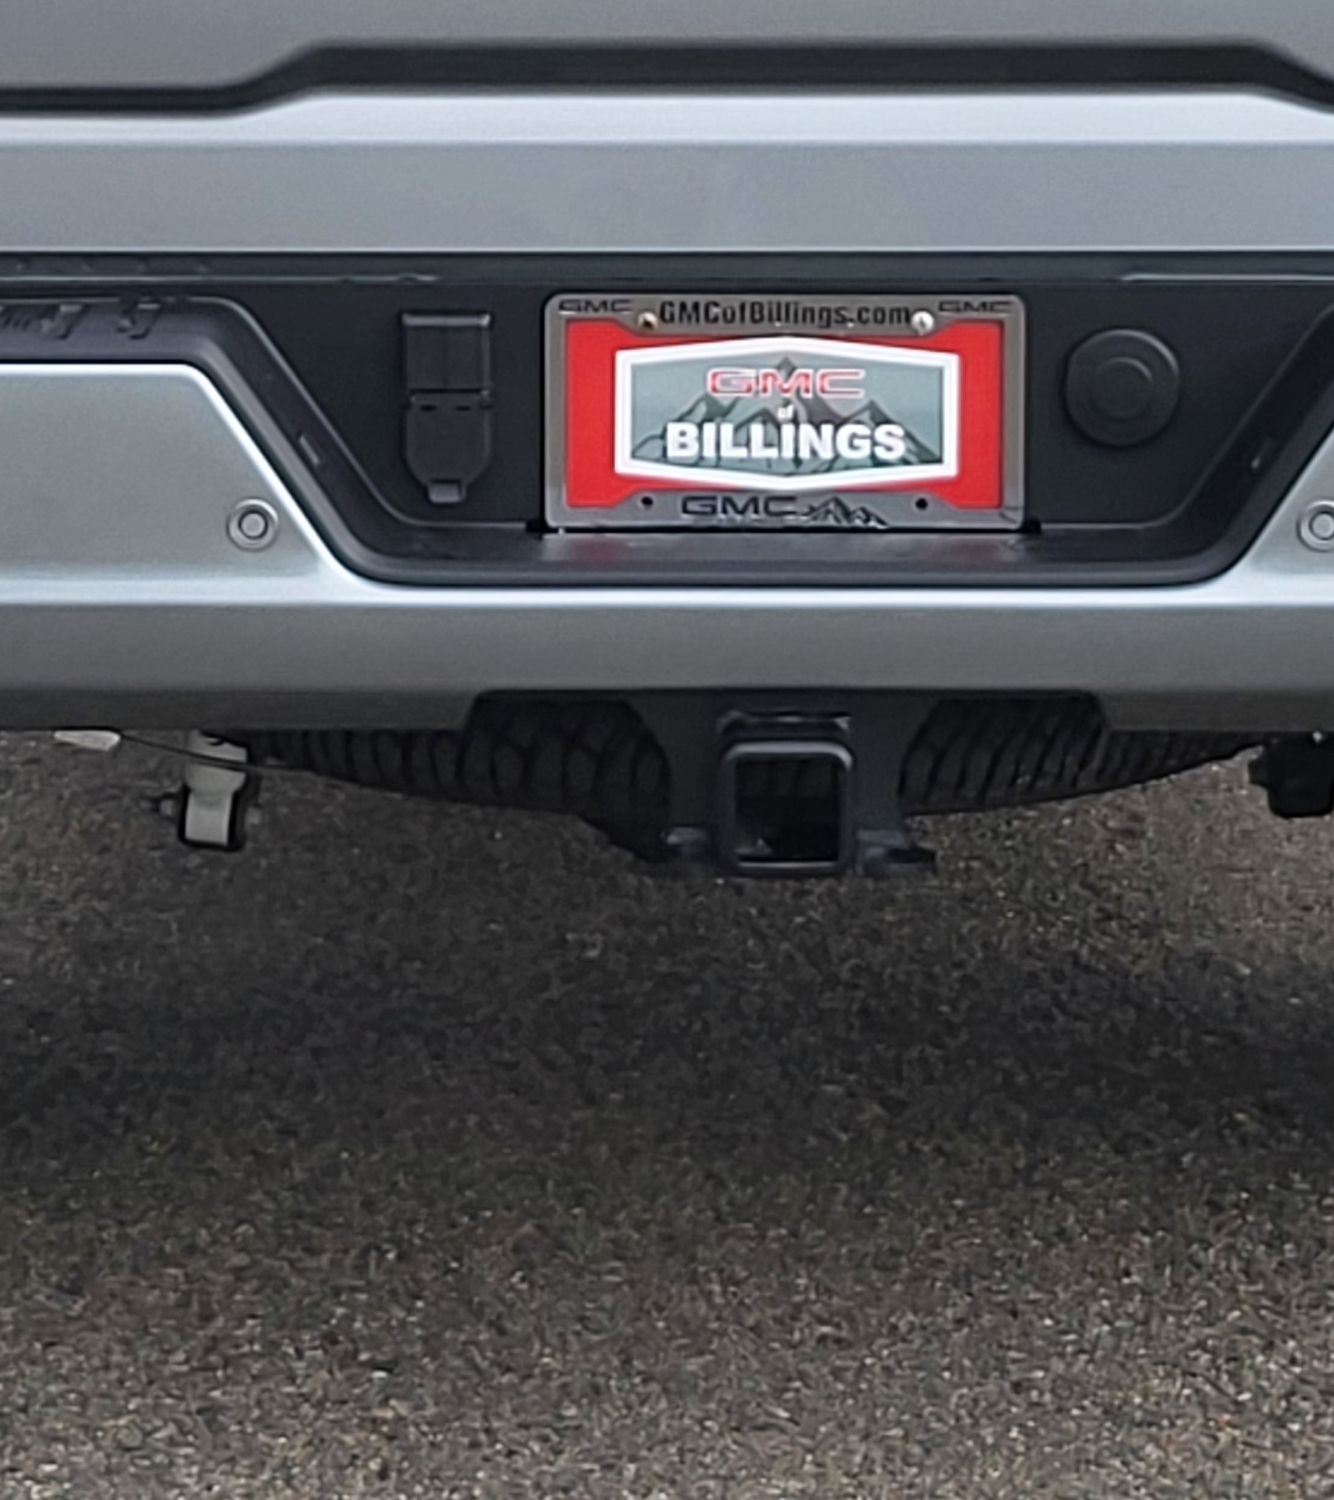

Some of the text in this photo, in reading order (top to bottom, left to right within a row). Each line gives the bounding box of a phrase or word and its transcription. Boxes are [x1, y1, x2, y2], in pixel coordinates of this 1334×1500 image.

[559, 299, 1012, 329] GMC GMCofBillings.com GMC
[706, 367, 865, 398] GMC
[666, 421, 907, 460] BILLINGS
[681, 496, 797, 519] GMC
